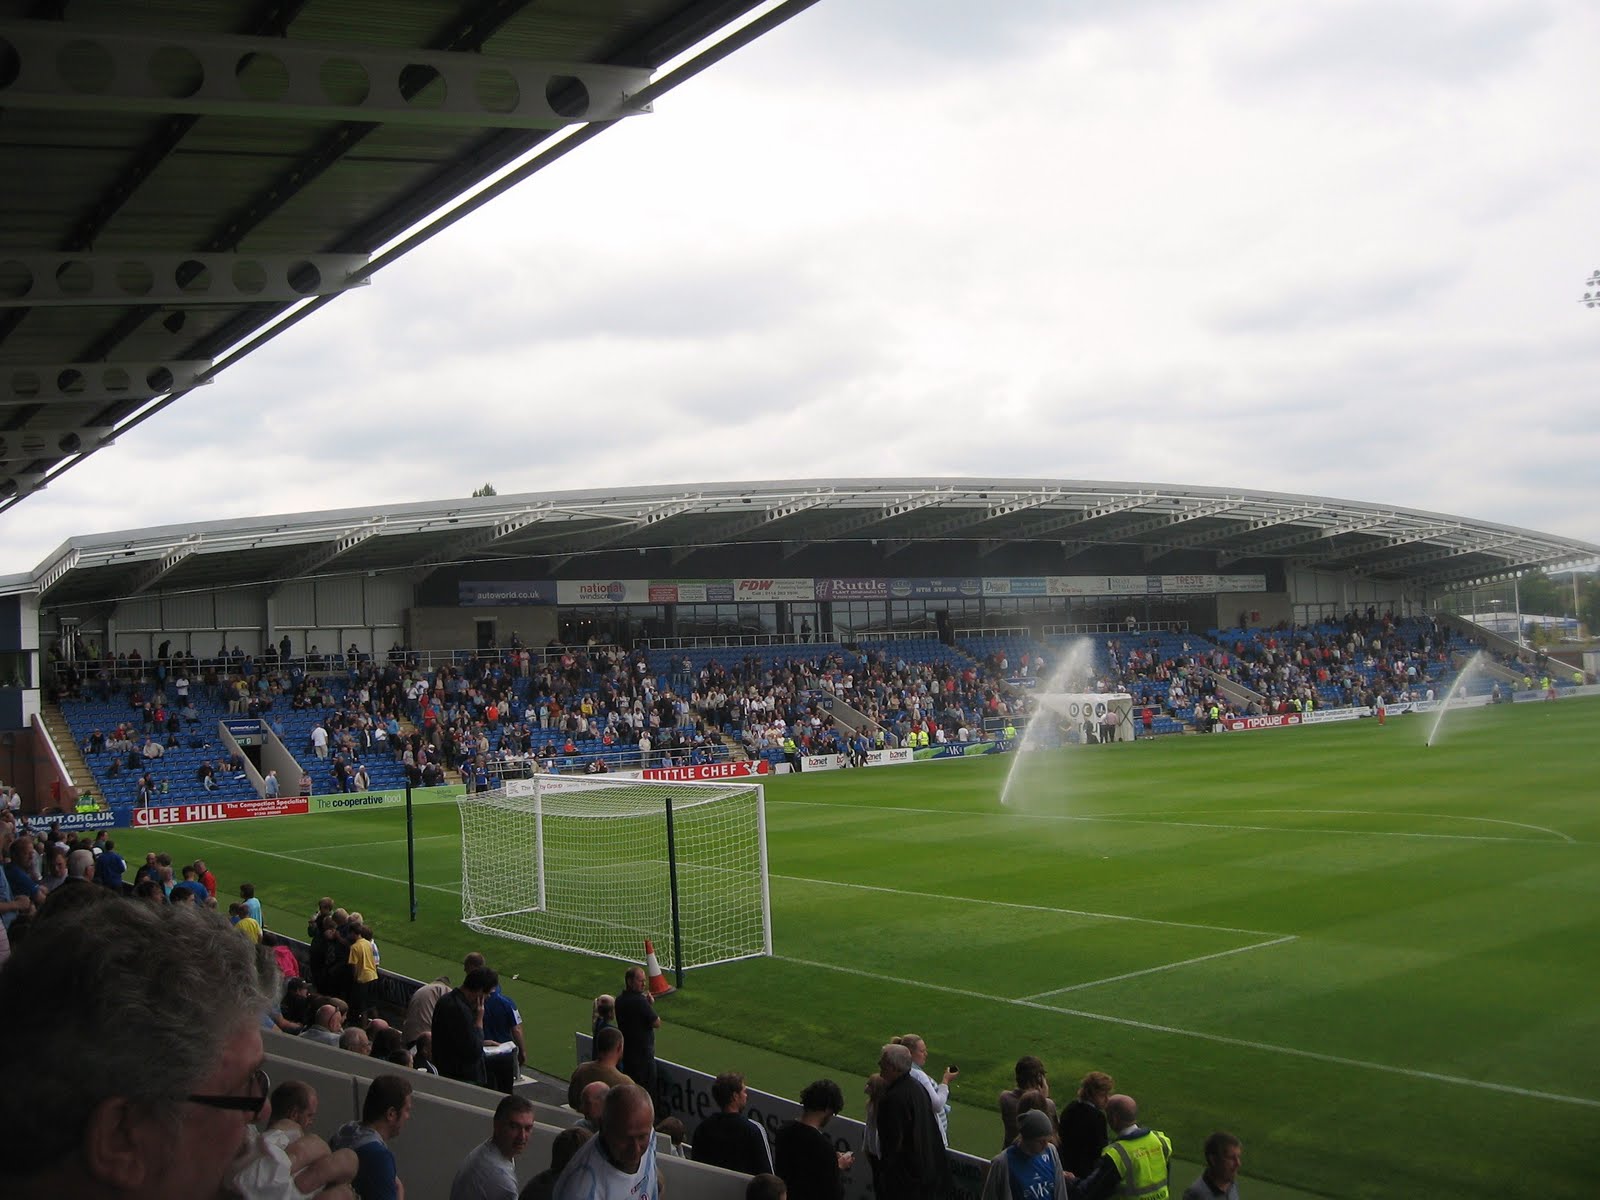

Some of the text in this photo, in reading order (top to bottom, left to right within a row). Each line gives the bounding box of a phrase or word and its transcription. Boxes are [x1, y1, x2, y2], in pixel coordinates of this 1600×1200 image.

[580, 583, 623, 593] national
[739, 581, 774, 590] FDW
[832, 579, 887, 590] Ruttle
[477, 590, 540, 600] autoworld.co.uk
[1247, 715, 1284, 728] npower
[890, 750, 907, 758] b2net
[809, 757, 827, 765] b2net
[650, 765, 737, 780] LITTLE CHEF
[317, 794, 401, 808] The co-operative food
[137, 804, 227, 824] CLEE HILL
[85, 821, 115, 829] Operator
